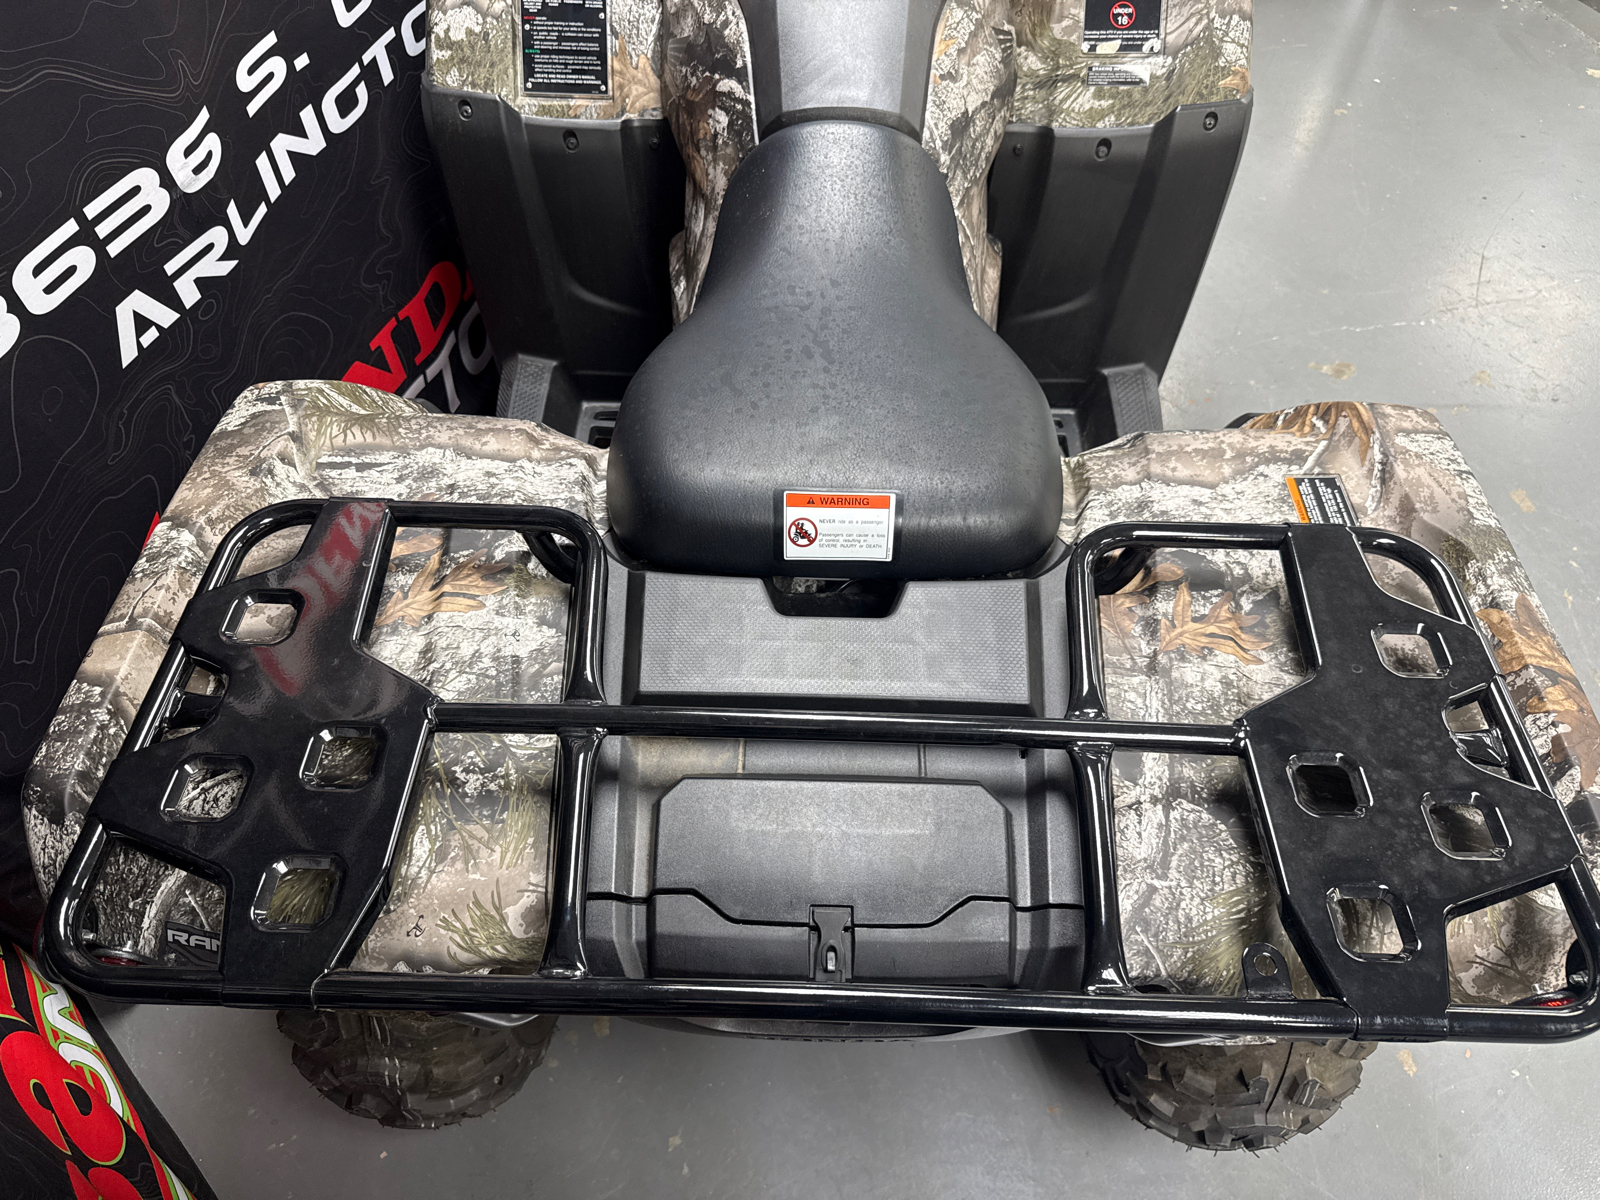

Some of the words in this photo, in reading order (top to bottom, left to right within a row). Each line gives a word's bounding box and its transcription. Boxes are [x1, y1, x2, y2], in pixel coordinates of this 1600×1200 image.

[1117, 16, 1128, 25] 16
[236, 30, 310, 118] S.
[820, 497, 870, 506] WARNING
